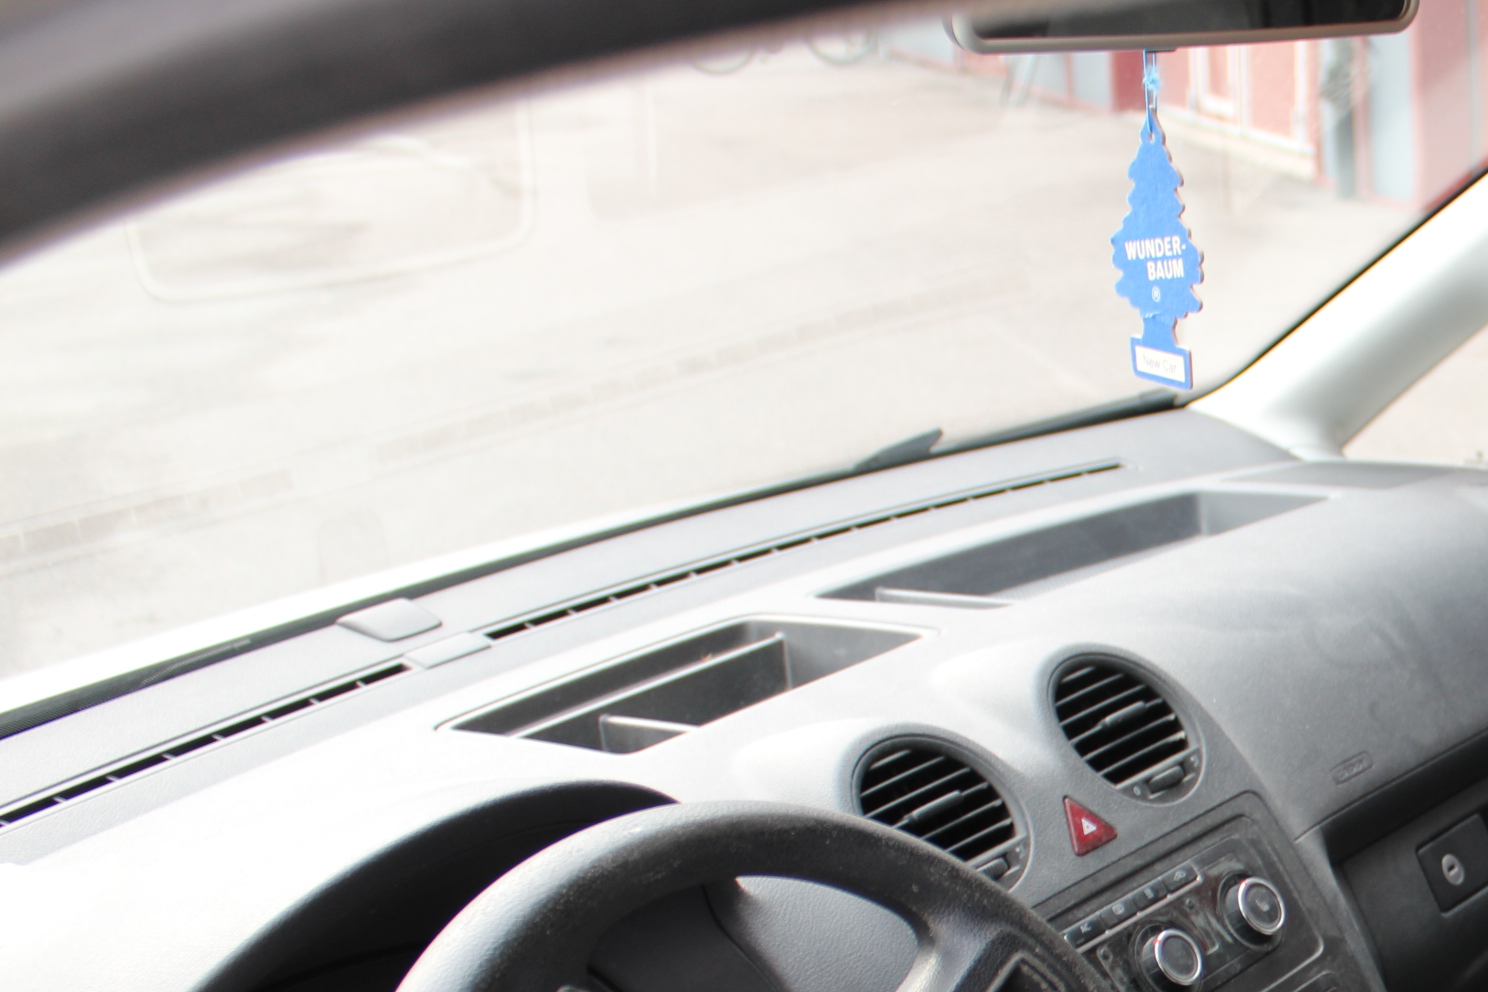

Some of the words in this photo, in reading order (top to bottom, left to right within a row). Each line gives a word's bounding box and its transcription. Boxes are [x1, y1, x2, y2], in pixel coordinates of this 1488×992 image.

[1124, 235, 1187, 261] WUNDER-
[1146, 258, 1185, 281] BAUM
[1142, 354, 1161, 371] New
[1162, 357, 1177, 374] Car
